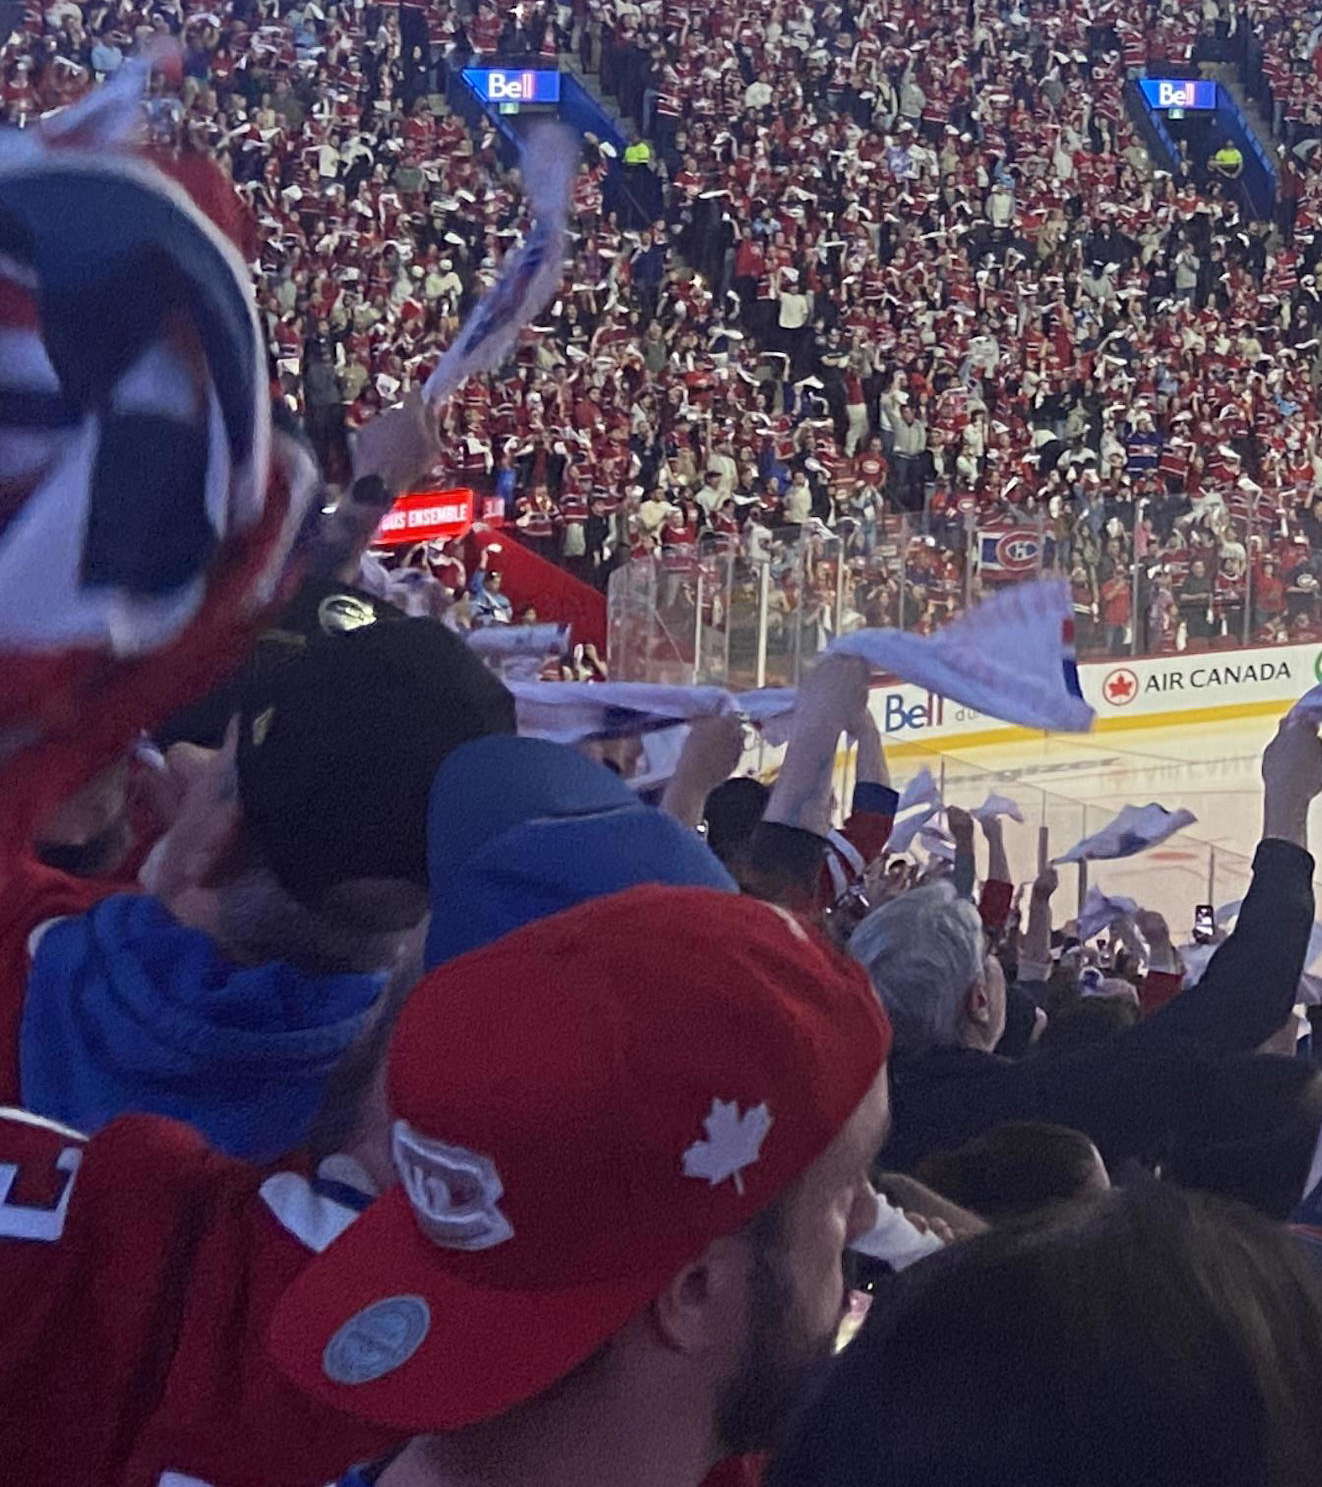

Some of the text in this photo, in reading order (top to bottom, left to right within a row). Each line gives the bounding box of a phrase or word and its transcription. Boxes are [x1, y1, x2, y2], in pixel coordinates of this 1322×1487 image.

[487, 73, 533, 100] Bell
[1158, 81, 1196, 107] Bell
[408, 505, 469, 526] ENSEMBLE
[1144, 661, 1292, 694] AIR CANADA
[885, 689, 944, 733] Bell
